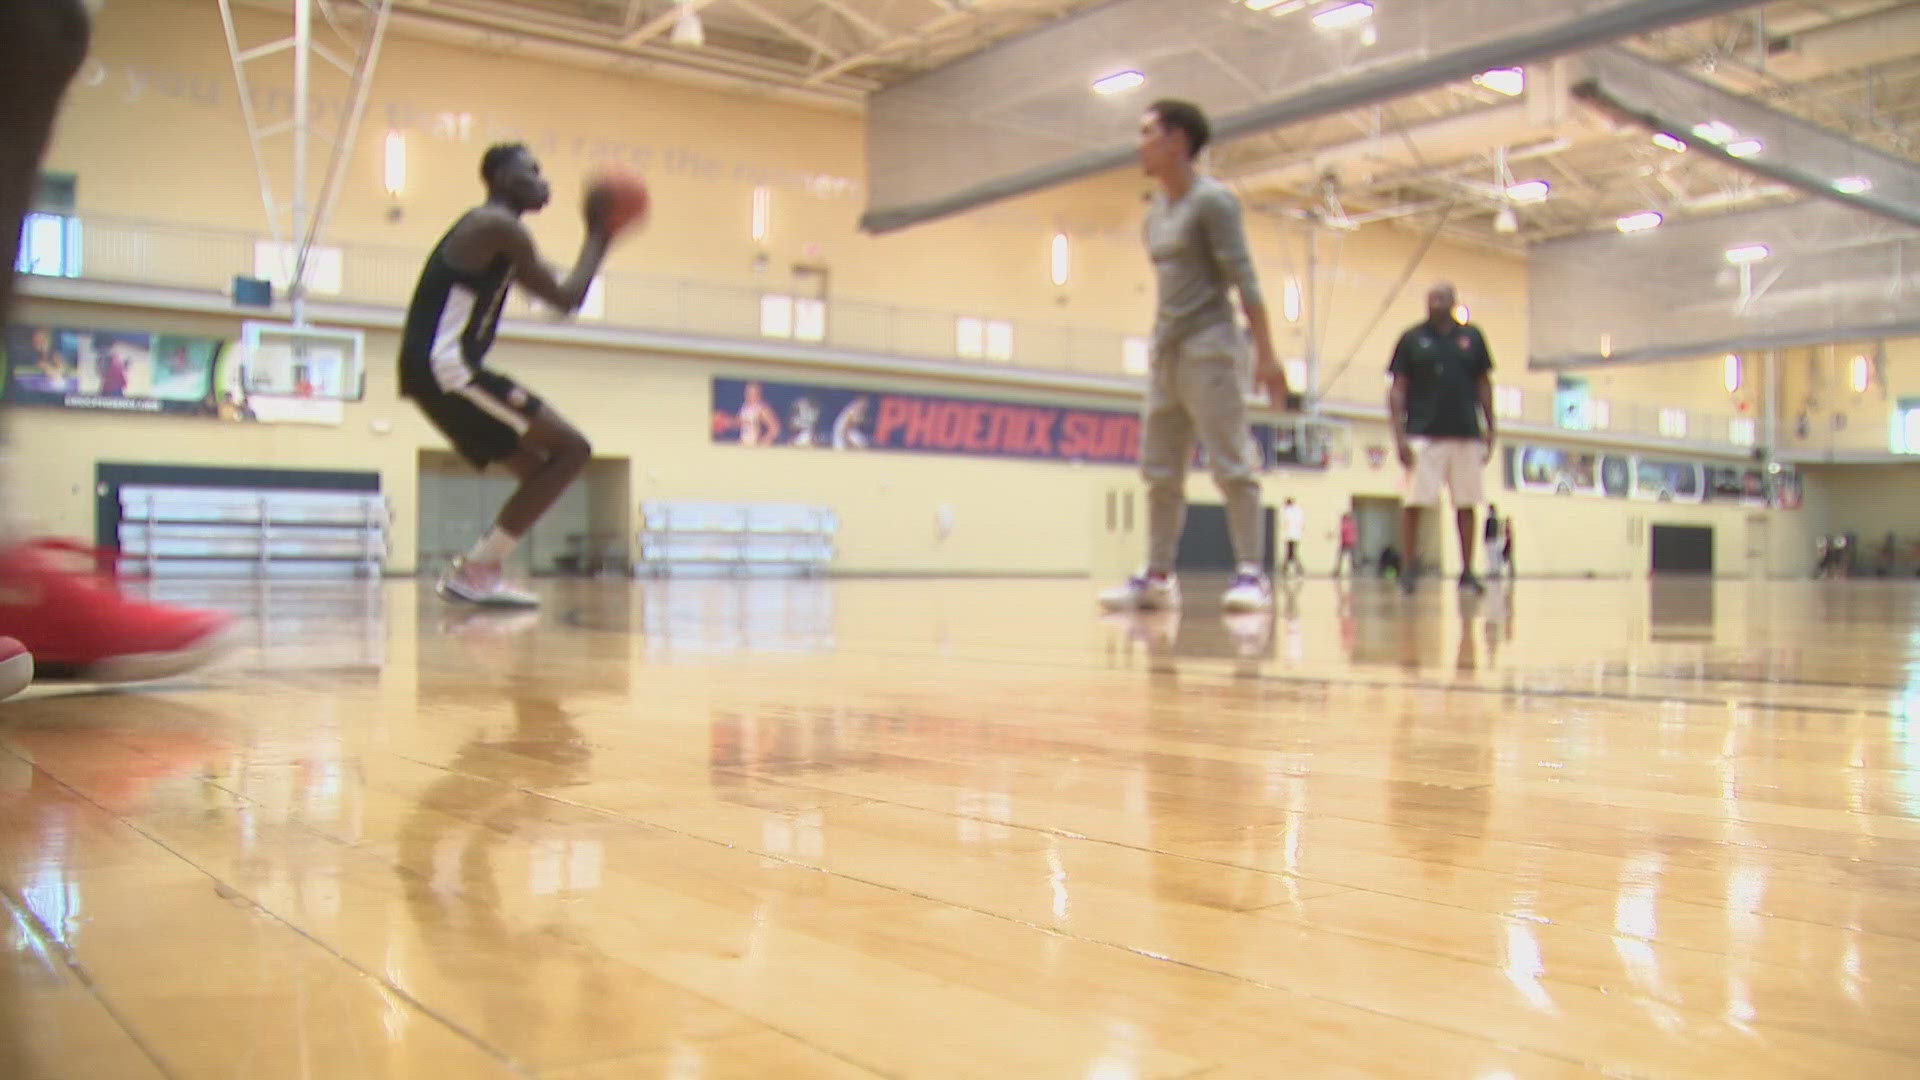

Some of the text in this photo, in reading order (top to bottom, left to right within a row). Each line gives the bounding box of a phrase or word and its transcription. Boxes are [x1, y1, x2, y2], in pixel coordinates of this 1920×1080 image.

[121, 64, 220, 106] you
[662, 143, 722, 180] the
[874, 395, 1141, 460] PHOENIX SUN
